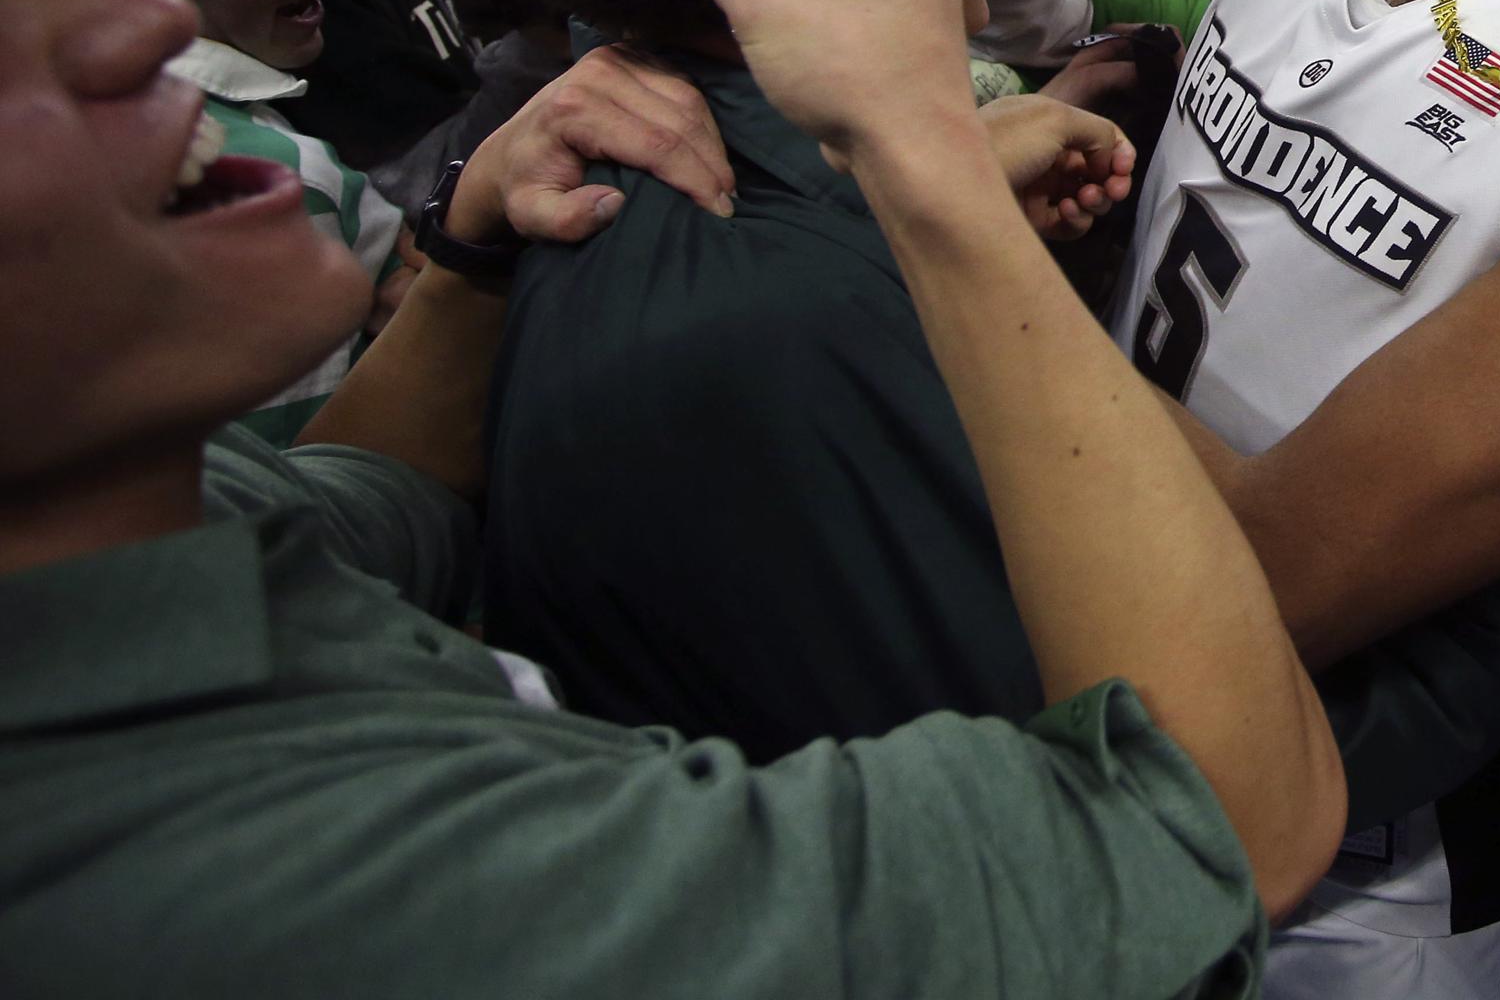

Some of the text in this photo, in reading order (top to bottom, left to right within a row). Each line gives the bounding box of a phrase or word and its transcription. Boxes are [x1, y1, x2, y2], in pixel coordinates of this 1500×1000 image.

[1178, 20, 1441, 282] PROVIDENCE
[1414, 111, 1466, 146] EAST
[1425, 103, 1465, 129] BIG
[1133, 184, 1249, 402] 5
